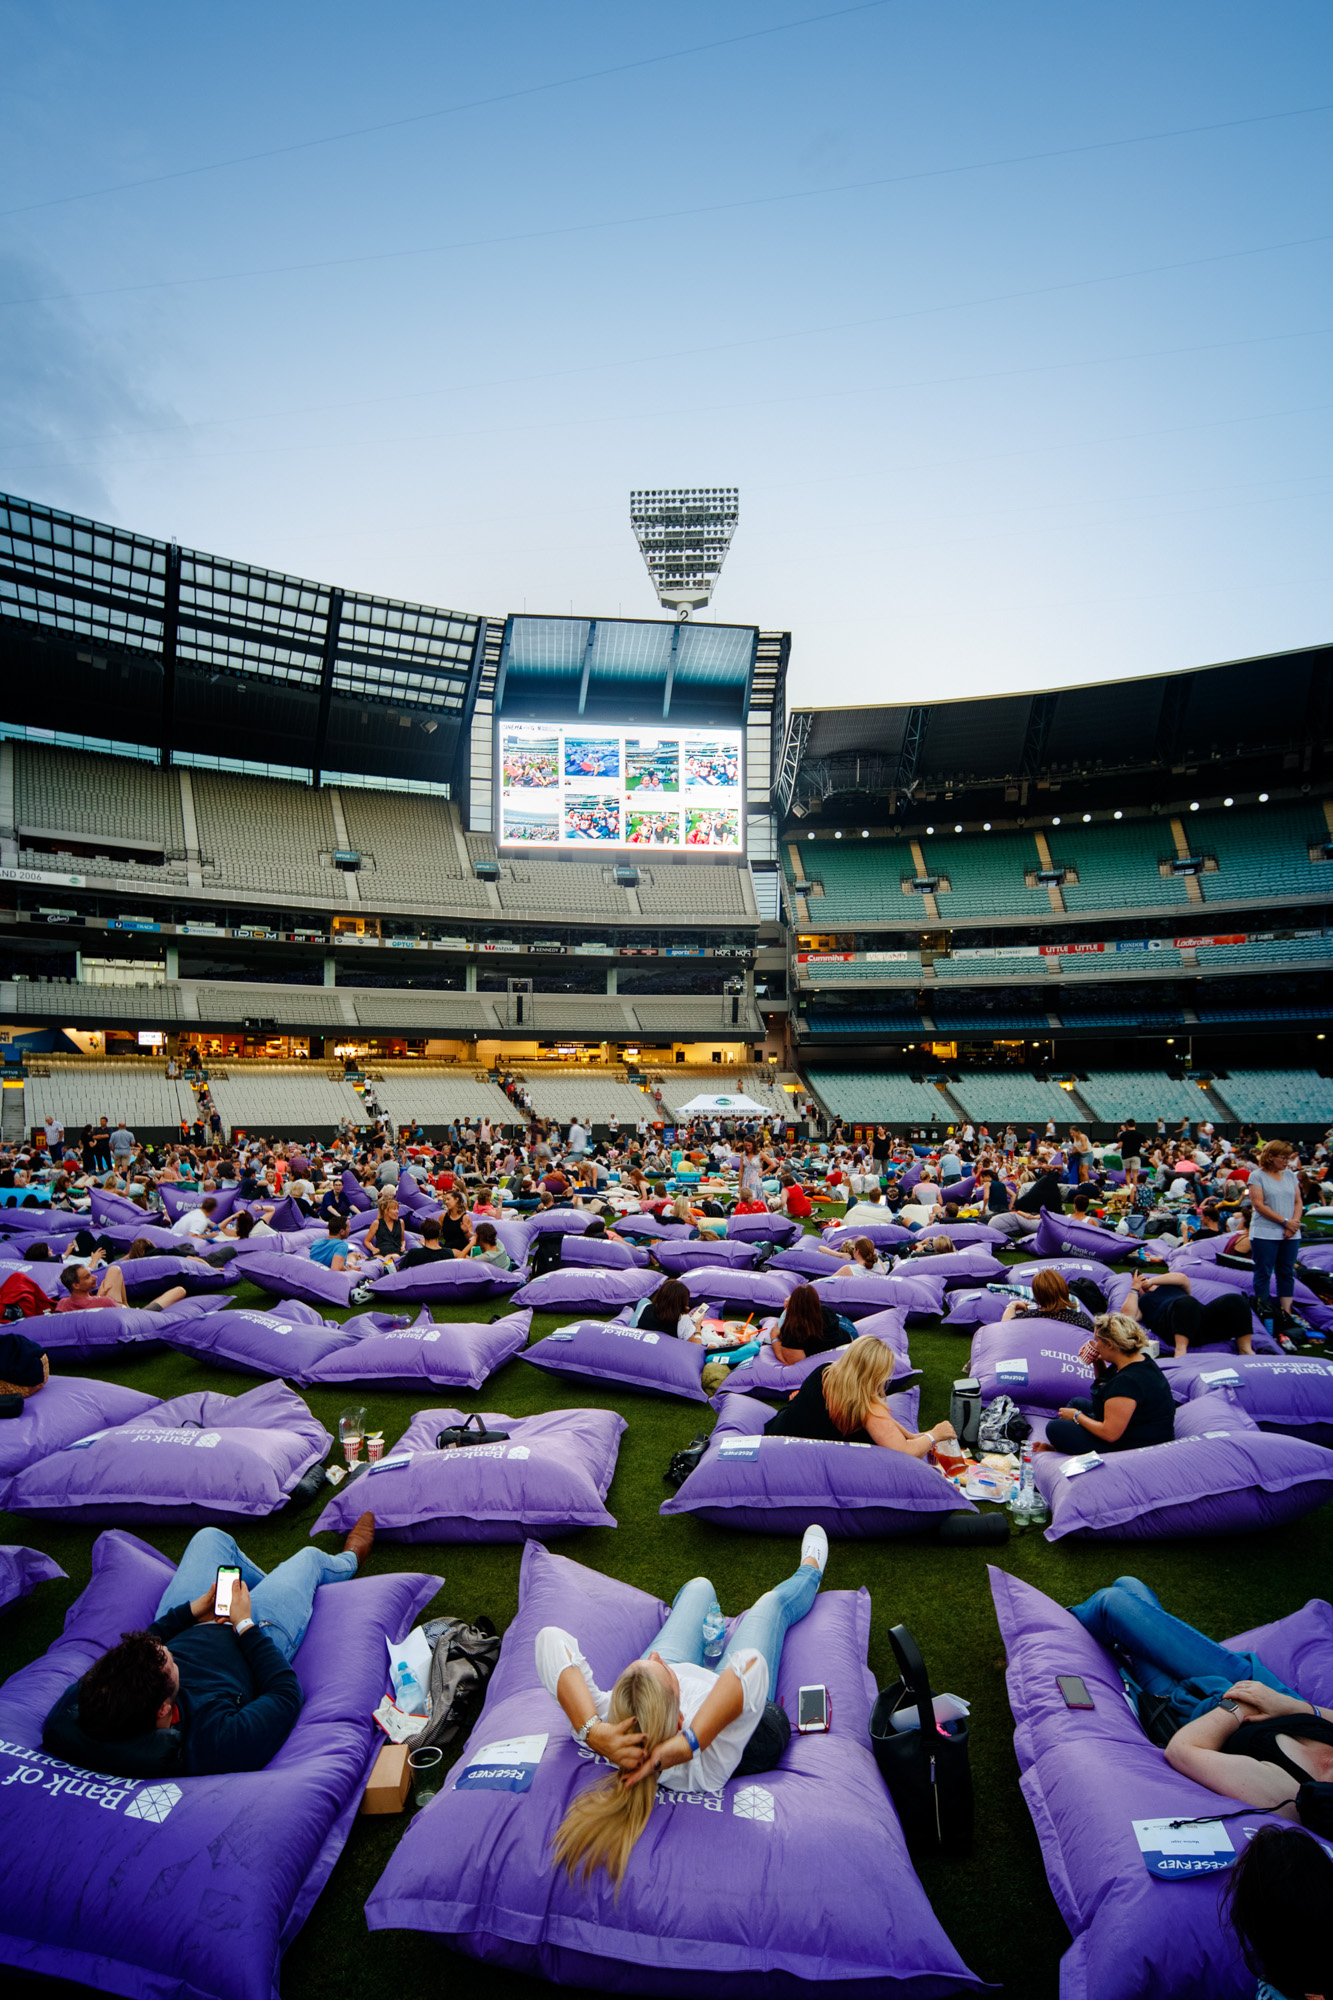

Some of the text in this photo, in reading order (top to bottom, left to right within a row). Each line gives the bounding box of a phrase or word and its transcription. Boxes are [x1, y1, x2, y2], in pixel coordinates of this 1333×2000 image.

[680, 610, 689, 622] 2
[0, 870, 42, 881] ND 2006
[234, 930, 276, 939] IDIOM
[807, 954, 844, 962] Cummins
[397, 1332, 422, 1340] Bank
[614, 1331, 642, 1340] Bank
[1061, 1363, 1075, 1373] of
[1272, 1367, 1328, 1376] Bank of
[131, 1434, 195, 1446] Bank of
[443, 1450, 504, 1461] Bank of
[468, 1769, 526, 1780] RESERVED
[1, 1764, 130, 1810] Bank of
